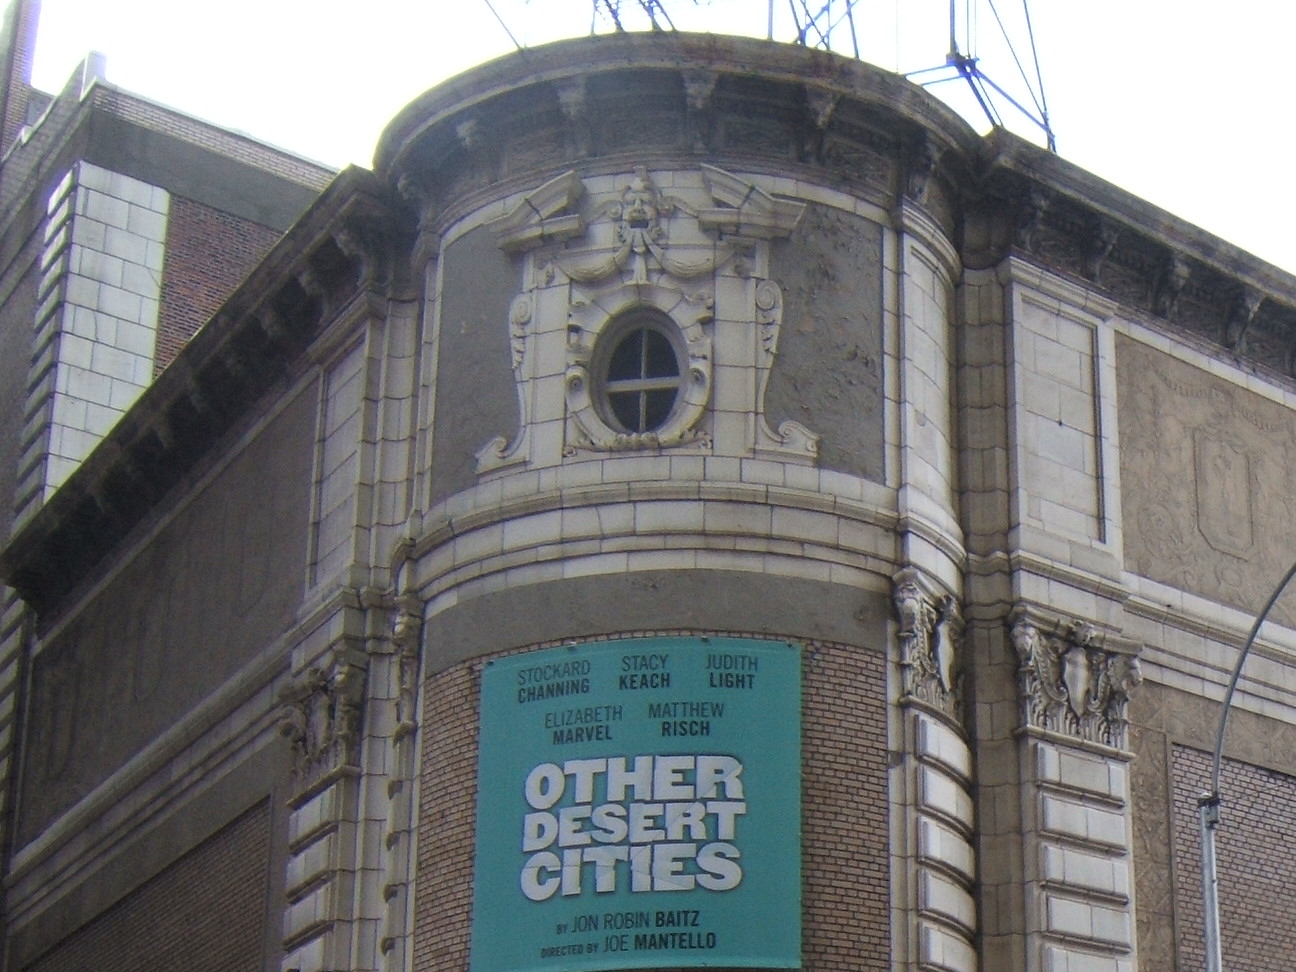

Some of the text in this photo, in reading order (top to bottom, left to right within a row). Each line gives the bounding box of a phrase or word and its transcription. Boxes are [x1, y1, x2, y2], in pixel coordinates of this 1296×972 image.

[518, 660, 591, 685] STOCKARD
[622, 654, 669, 671] STACY
[706, 653, 758, 671] JUDITH
[518, 678, 590, 703] CHANNING
[619, 673, 670, 690] KEACH
[709, 673, 756, 690] LIGHT
[545, 705, 623, 729] ELIZABETH
[648, 702, 724, 719] MATTHEW
[553, 726, 612, 745] MARVEL
[661, 720, 710, 737] RISCH
[524, 755, 745, 810] OTHER
[523, 802, 747, 852] DESERT
[520, 843, 743, 901] CITIES
[556, 910, 700, 935] BY JON ROBIN BAITZ
[541, 932, 717, 958] DIRECTED BY JOE MANTELLO
